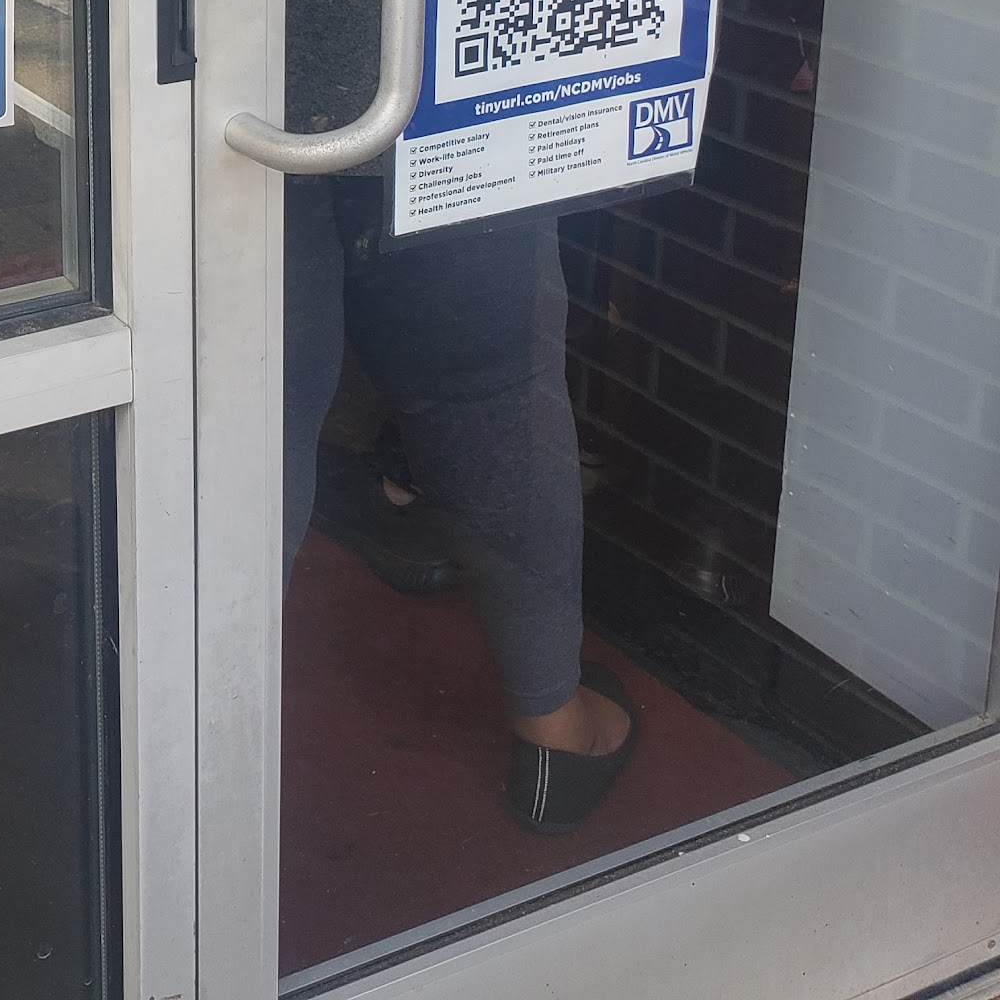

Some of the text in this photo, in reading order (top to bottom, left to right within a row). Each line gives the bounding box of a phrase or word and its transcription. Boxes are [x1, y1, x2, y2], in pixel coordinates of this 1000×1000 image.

[475, 72, 642, 116] tinyurl.com/NCDMVjobs
[537, 104, 623, 127] Dental/vision insurance
[635, 92, 690, 128] DMV
[537, 121, 600, 140] Retirement plans
[419, 132, 490, 153] Competitive salary
[537, 136, 586, 152] Paid holidays
[419, 146, 485, 166] Work-life balance
[537, 148, 585, 164] Paid time off
[418, 165, 454, 178] Diversity
[537, 158, 602, 177] Military transition
[418, 171, 482, 190] Challenging jobs
[418, 176, 516, 203] Professional development
[418, 196, 482, 215] Health insurance
